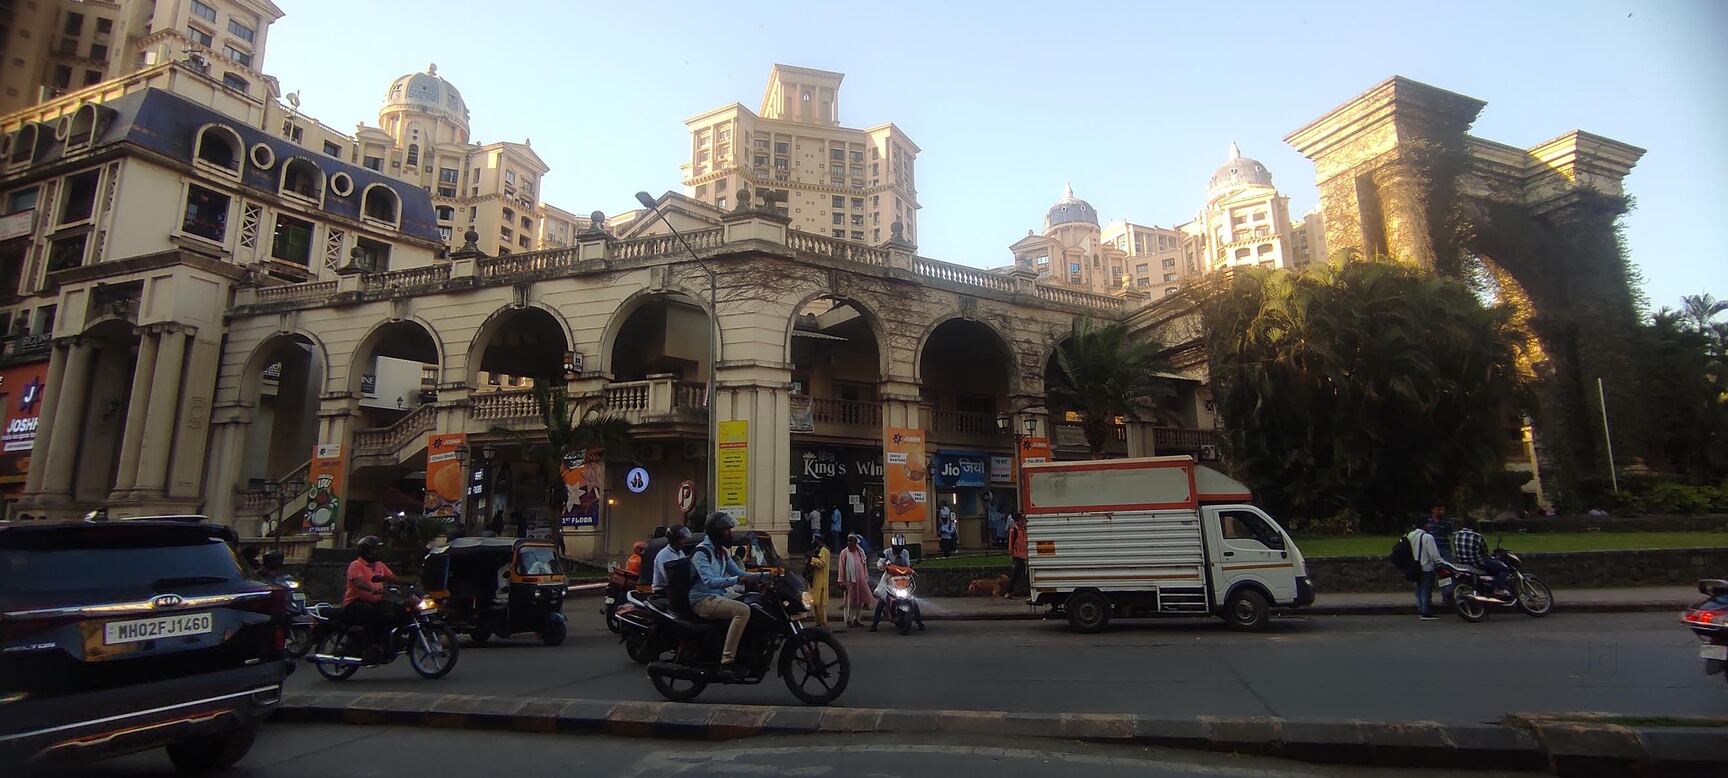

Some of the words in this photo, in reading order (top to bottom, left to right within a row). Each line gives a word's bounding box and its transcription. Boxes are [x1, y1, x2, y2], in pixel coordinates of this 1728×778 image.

[803, 458, 847, 479] King's
[941, 462, 960, 476] Jio
[959, 457, 984, 474] जियो
[571, 516, 593, 524] FLOOR
[156, 596, 179, 606] KIA
[118, 616, 210, 641] MH02FJ1460
